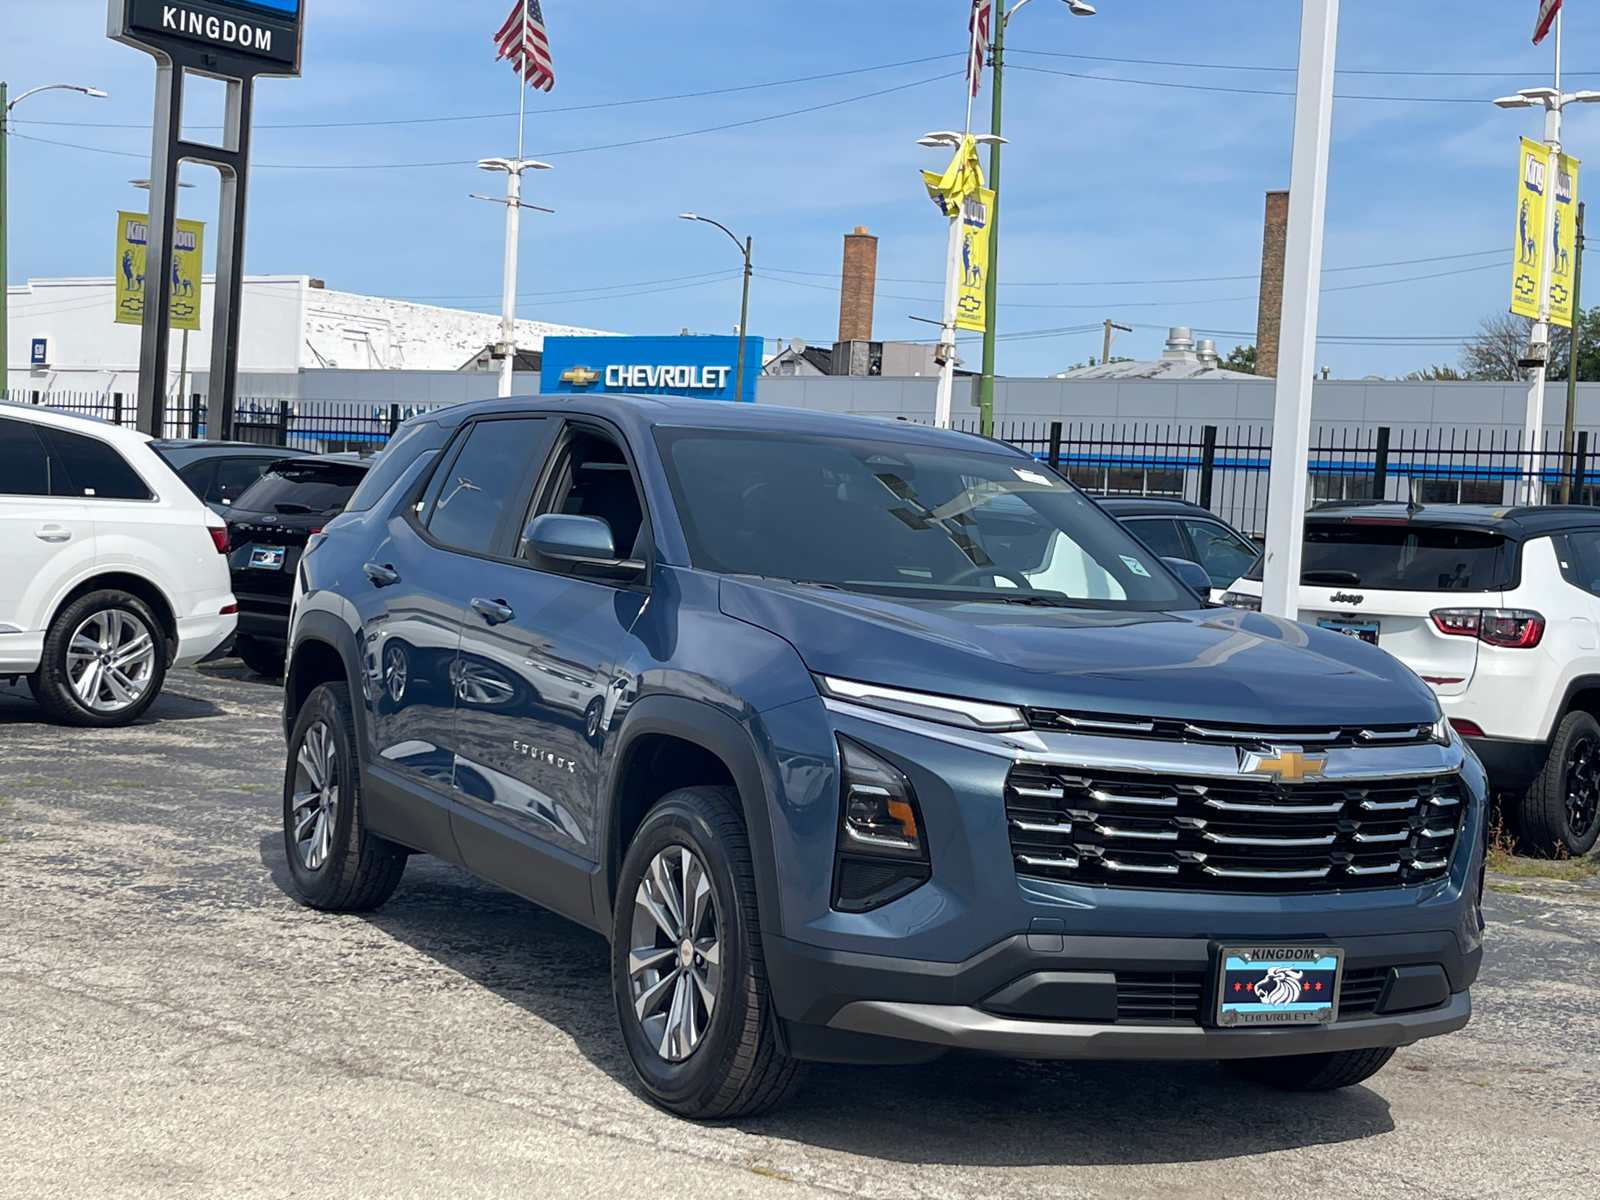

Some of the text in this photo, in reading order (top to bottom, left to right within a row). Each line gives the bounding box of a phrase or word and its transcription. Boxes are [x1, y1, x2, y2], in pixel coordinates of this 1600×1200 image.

[162, 6, 272, 51] KINGDOM
[126, 220, 148, 242] Kin
[605, 364, 731, 388] CHEVROLET
[1330, 591, 1364, 606] Jeep
[1251, 948, 1315, 960] KINGDOM
[1244, 1012, 1307, 1022] CHEVROLET
